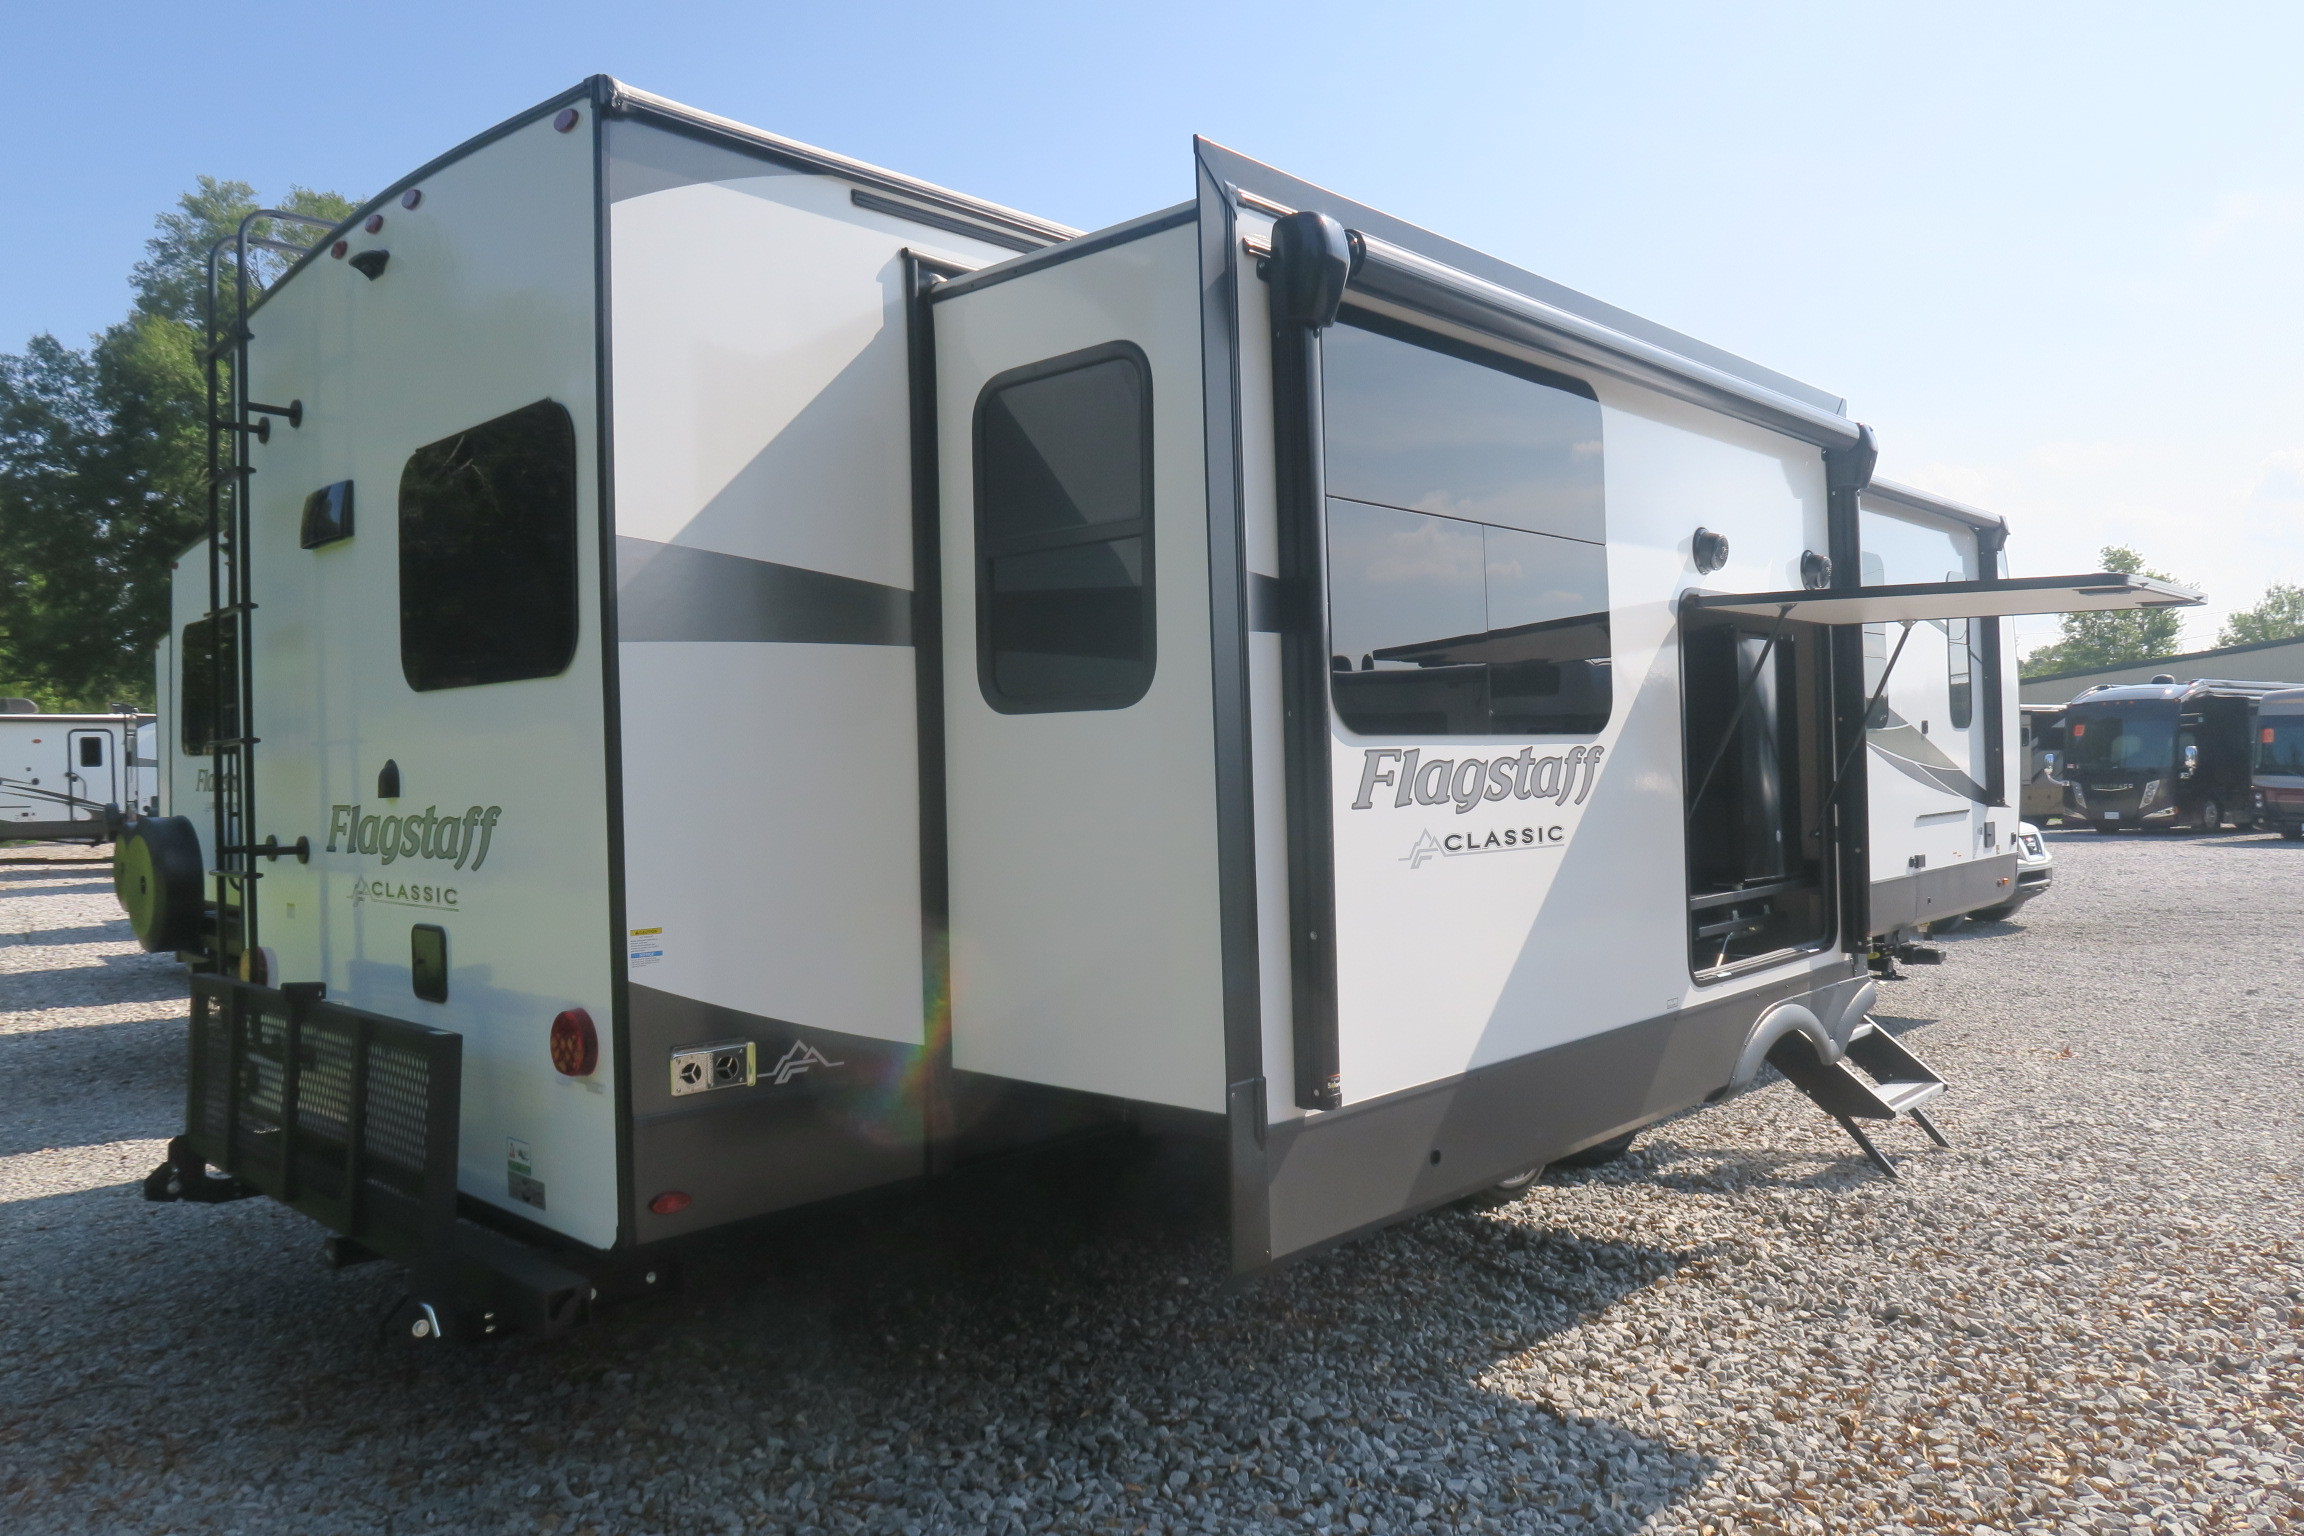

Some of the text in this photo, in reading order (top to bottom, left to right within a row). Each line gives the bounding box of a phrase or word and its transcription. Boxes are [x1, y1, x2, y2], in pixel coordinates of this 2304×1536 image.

[1351, 745, 1605, 815] Flagstaff
[326, 804, 502, 872] Flagstaff
[1443, 825, 1564, 851] CLASSIC
[371, 881, 458, 905] CLASSIC
